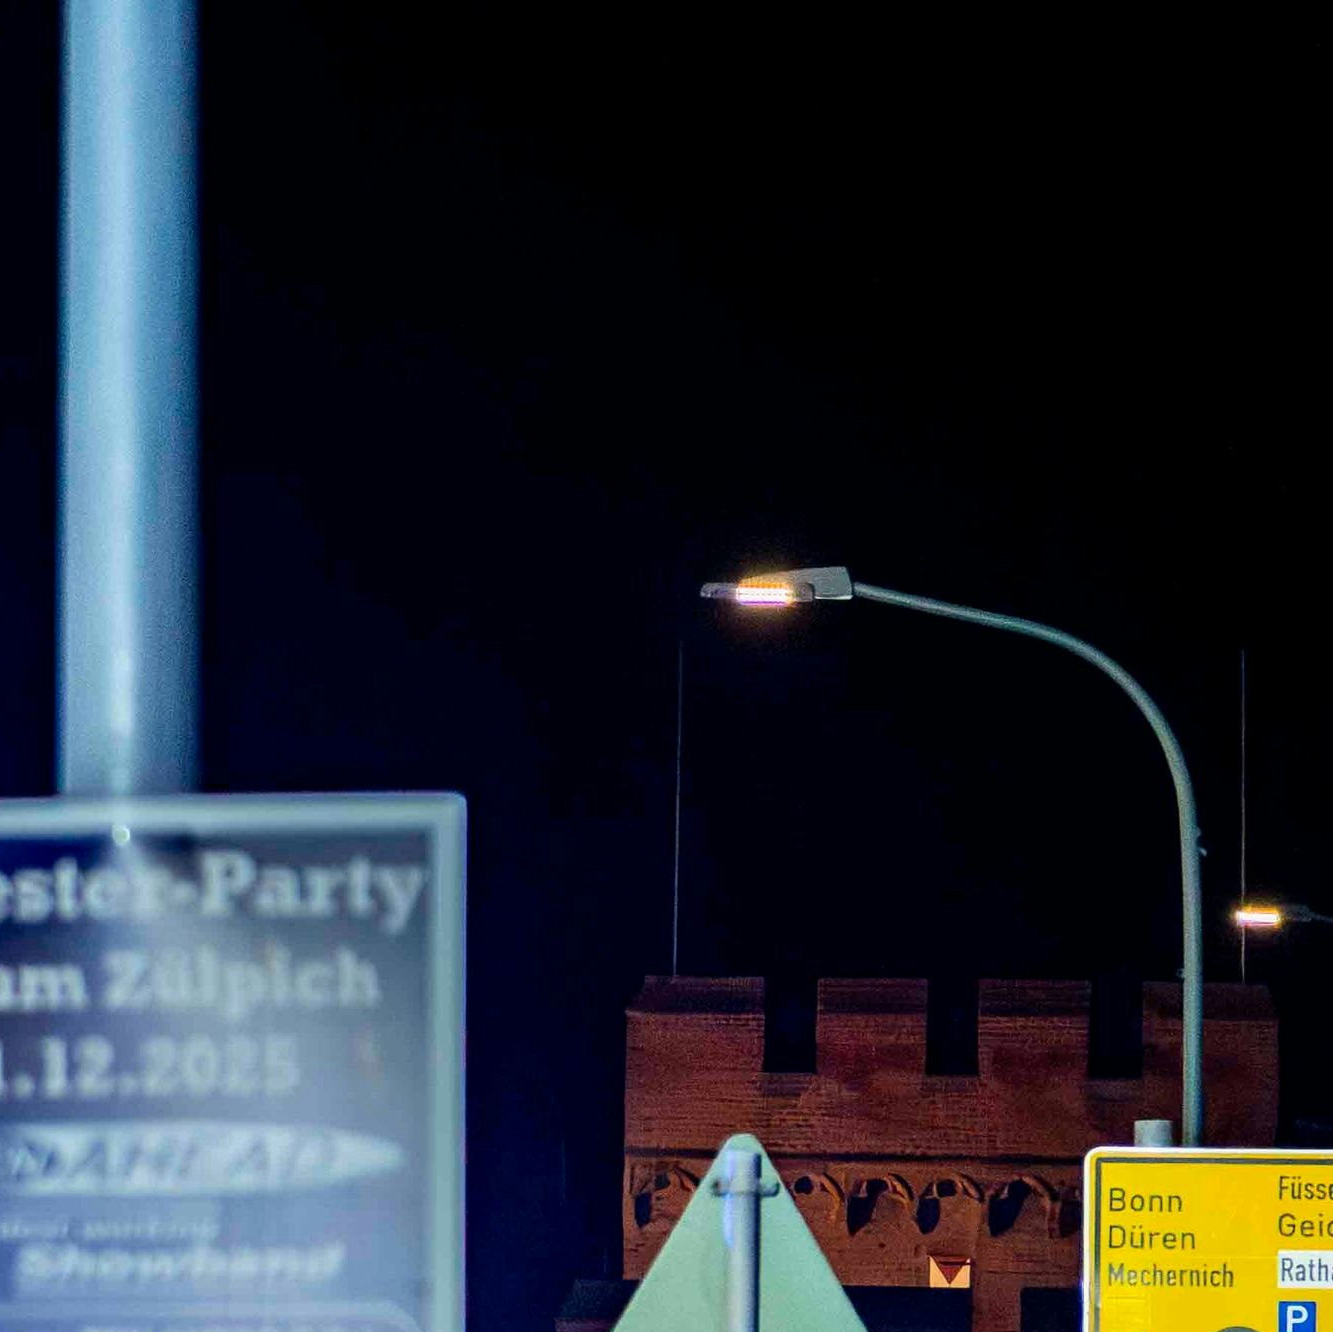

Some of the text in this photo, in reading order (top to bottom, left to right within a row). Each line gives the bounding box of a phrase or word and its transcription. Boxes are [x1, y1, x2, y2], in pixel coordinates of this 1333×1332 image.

[103, 942, 383, 1021] Zülpich
[1109, 1187, 1183, 1212] Bonn
[1108, 1224, 1196, 1249] Düren
[1108, 1262, 1234, 1288] Mechernich
[1281, 1257, 1333, 1283] Rath
